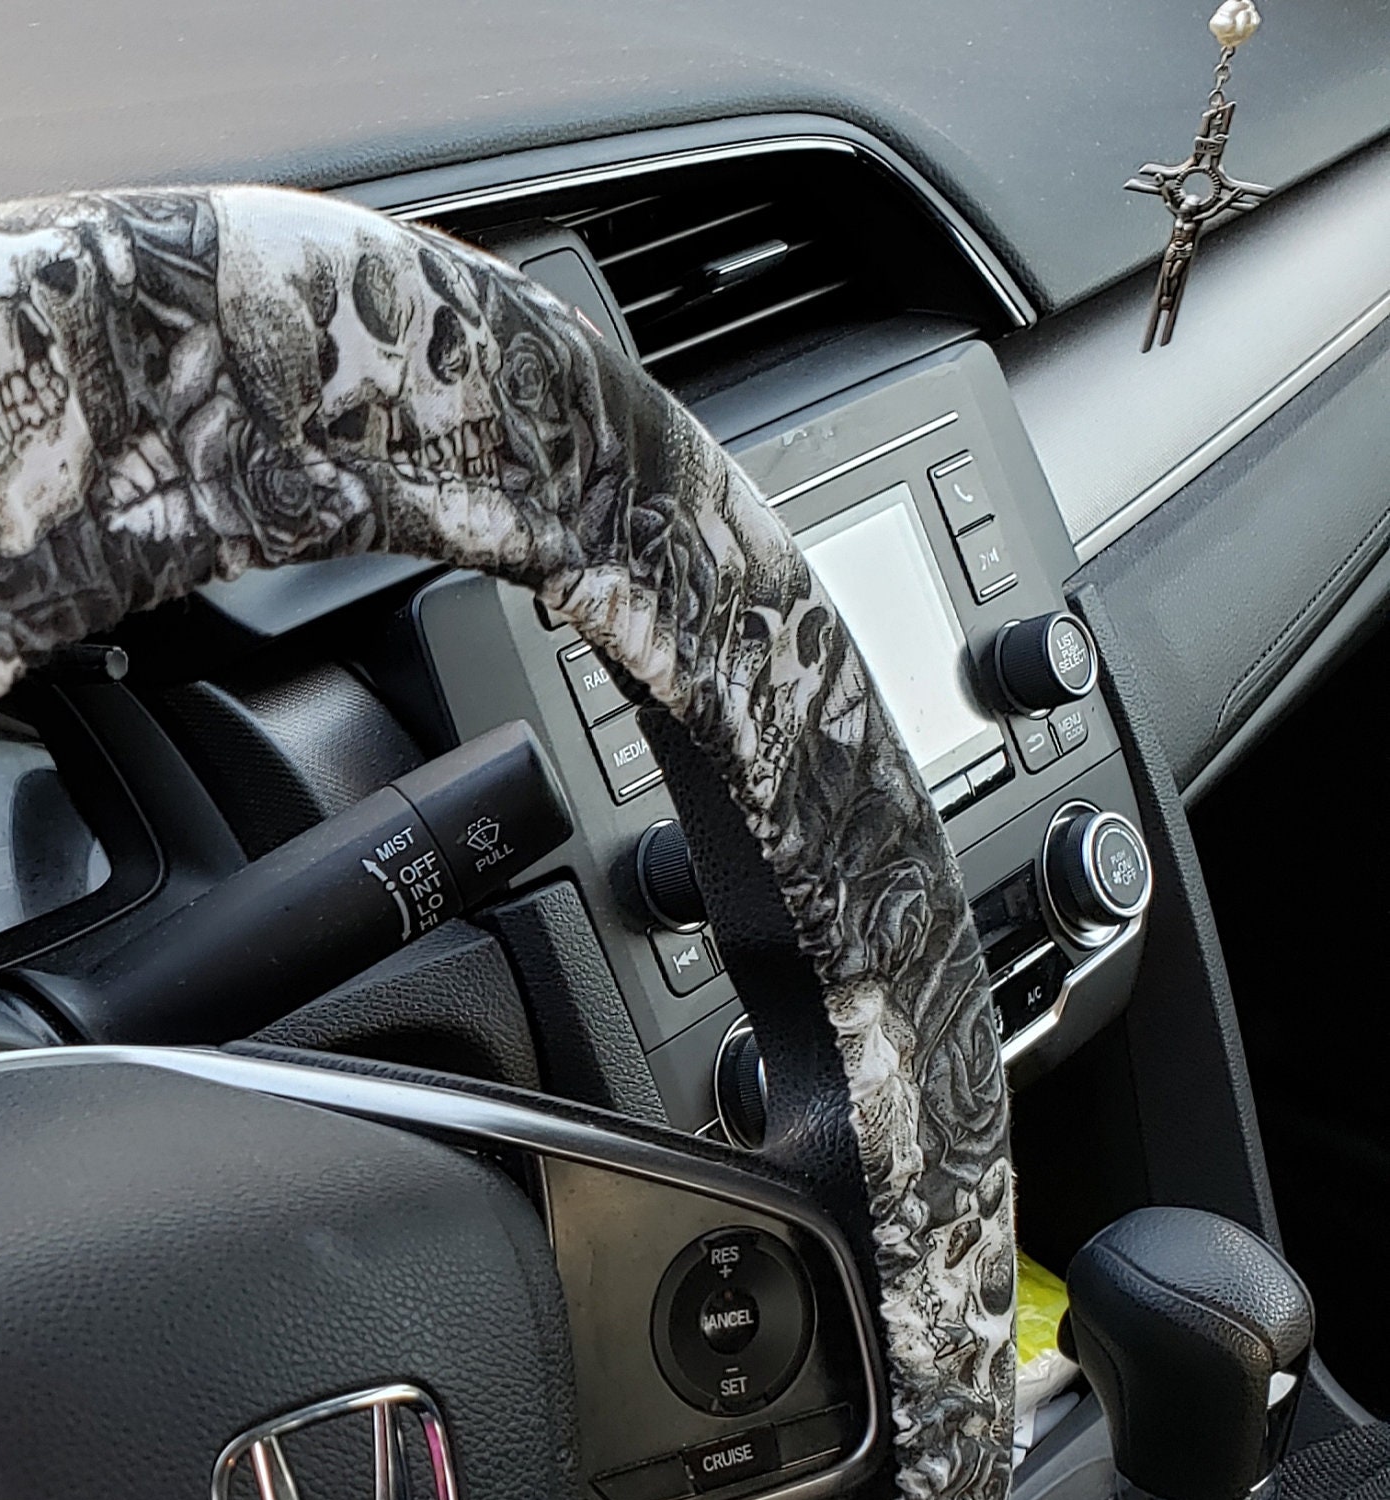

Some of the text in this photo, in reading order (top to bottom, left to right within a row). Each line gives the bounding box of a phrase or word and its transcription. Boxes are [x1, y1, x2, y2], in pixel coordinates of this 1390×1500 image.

[1057, 631, 1075, 650] LIST
[1058, 647, 1087, 674] SELECT
[1058, 711, 1081, 731] MENU
[613, 737, 650, 767] MEDIA
[375, 827, 415, 863] MIST
[475, 844, 514, 872] PULL
[398, 850, 438, 886] OFF
[409, 871, 442, 900] INT
[416, 893, 444, 918] LO
[419, 913, 439, 932] HI
[711, 1246, 740, 1265] RES
[720, 1376, 747, 1396] SET
[702, 1443, 754, 1473] CRUISE
